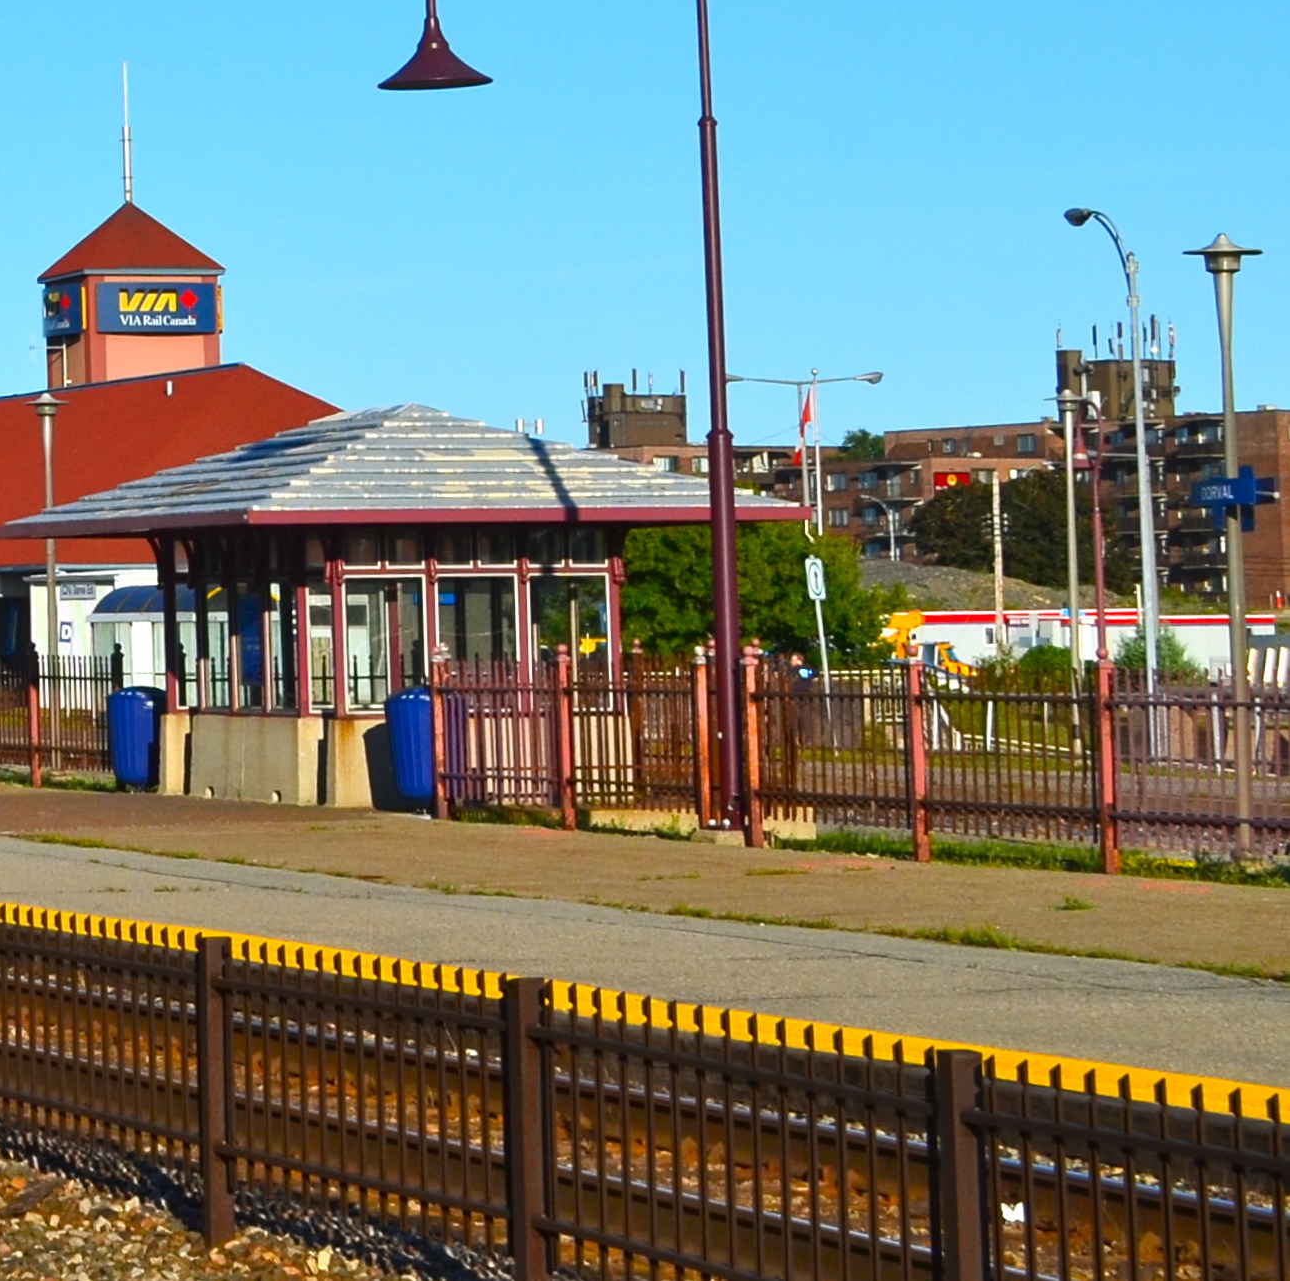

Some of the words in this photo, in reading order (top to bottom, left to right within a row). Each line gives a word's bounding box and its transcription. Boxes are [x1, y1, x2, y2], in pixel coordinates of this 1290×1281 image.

[118, 289, 178, 313] VIA
[119, 315, 142, 326] VIA
[143, 315, 162, 326] Rail
[163, 314, 197, 326] Canada
[1201, 484, 1235, 501] DORVAL
[61, 624, 72, 640] D
